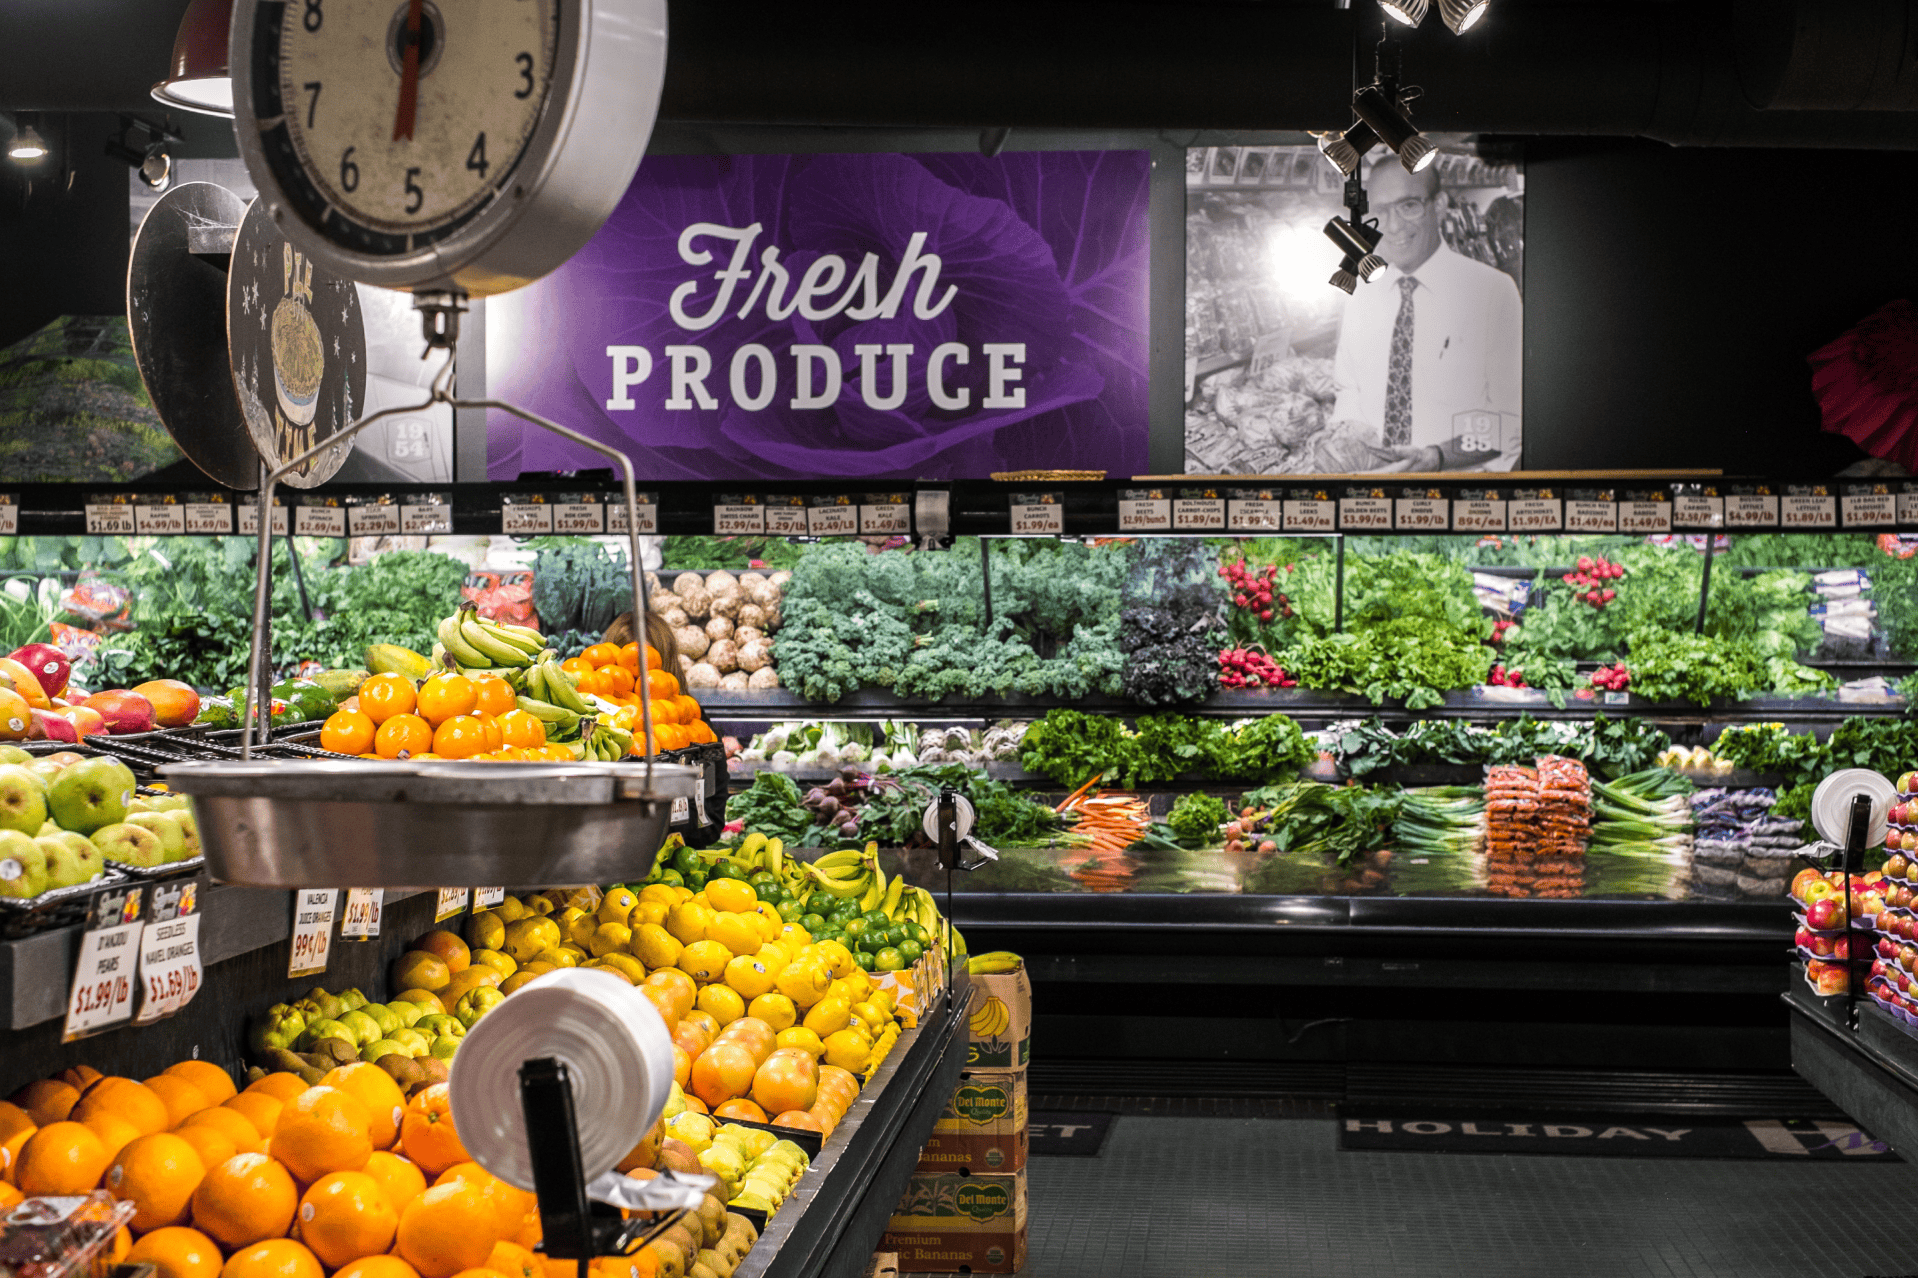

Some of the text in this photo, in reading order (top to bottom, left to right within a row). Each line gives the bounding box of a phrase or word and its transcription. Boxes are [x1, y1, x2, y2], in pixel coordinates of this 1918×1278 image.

[304, 0, 323, 32] 8
[514, 52, 534, 100] 3
[304, 82, 322, 128] 7
[466, 131, 489, 178] 4
[340, 146, 360, 193] 6
[404, 168, 424, 214] 5
[669, 222, 958, 331] Fresh
[606, 342, 1026, 411] PRODUCE
[397, 422, 423, 440] 19
[395, 440, 423, 457] 54
[1461, 434, 1492, 452] 85
[140, 520, 181, 531] $4.99/lb
[507, 520, 549, 530] $2.49/ea
[558, 519, 599, 530] $1.99/lb
[719, 521, 761, 532] $2.99/ea
[812, 520, 855, 532] $2.49/LB
[864, 519, 907, 531] $1.49/lb
[1016, 520, 1059, 531] $1.99/ea
[1178, 515, 1221, 526] $1.89/ea
[1286, 516, 1330, 528] $1.49/ea
[1343, 515, 1387, 526] $3.99/ea
[1400, 515, 1444, 527] $1.99/lb
[1512, 515, 1557, 527] $1.99/EA
[348, 901, 379, 930] $1.99/lb
[156, 922, 186, 941] SEEDLESS
[166, 941, 194, 961] ORANGES
[295, 930, 327, 962] 99¢/lb
[150, 965, 198, 1003] $1.69/lb
[75, 975, 129, 1015] $1.99/lb
[958, 1096, 1005, 1107] Del Monte
[1346, 1120, 1692, 1140] HOLIDAY
[959, 1194, 1006, 1205] Del Monte
[885, 1233, 941, 1245] Premium
[914, 1248, 972, 1261] Bananas
